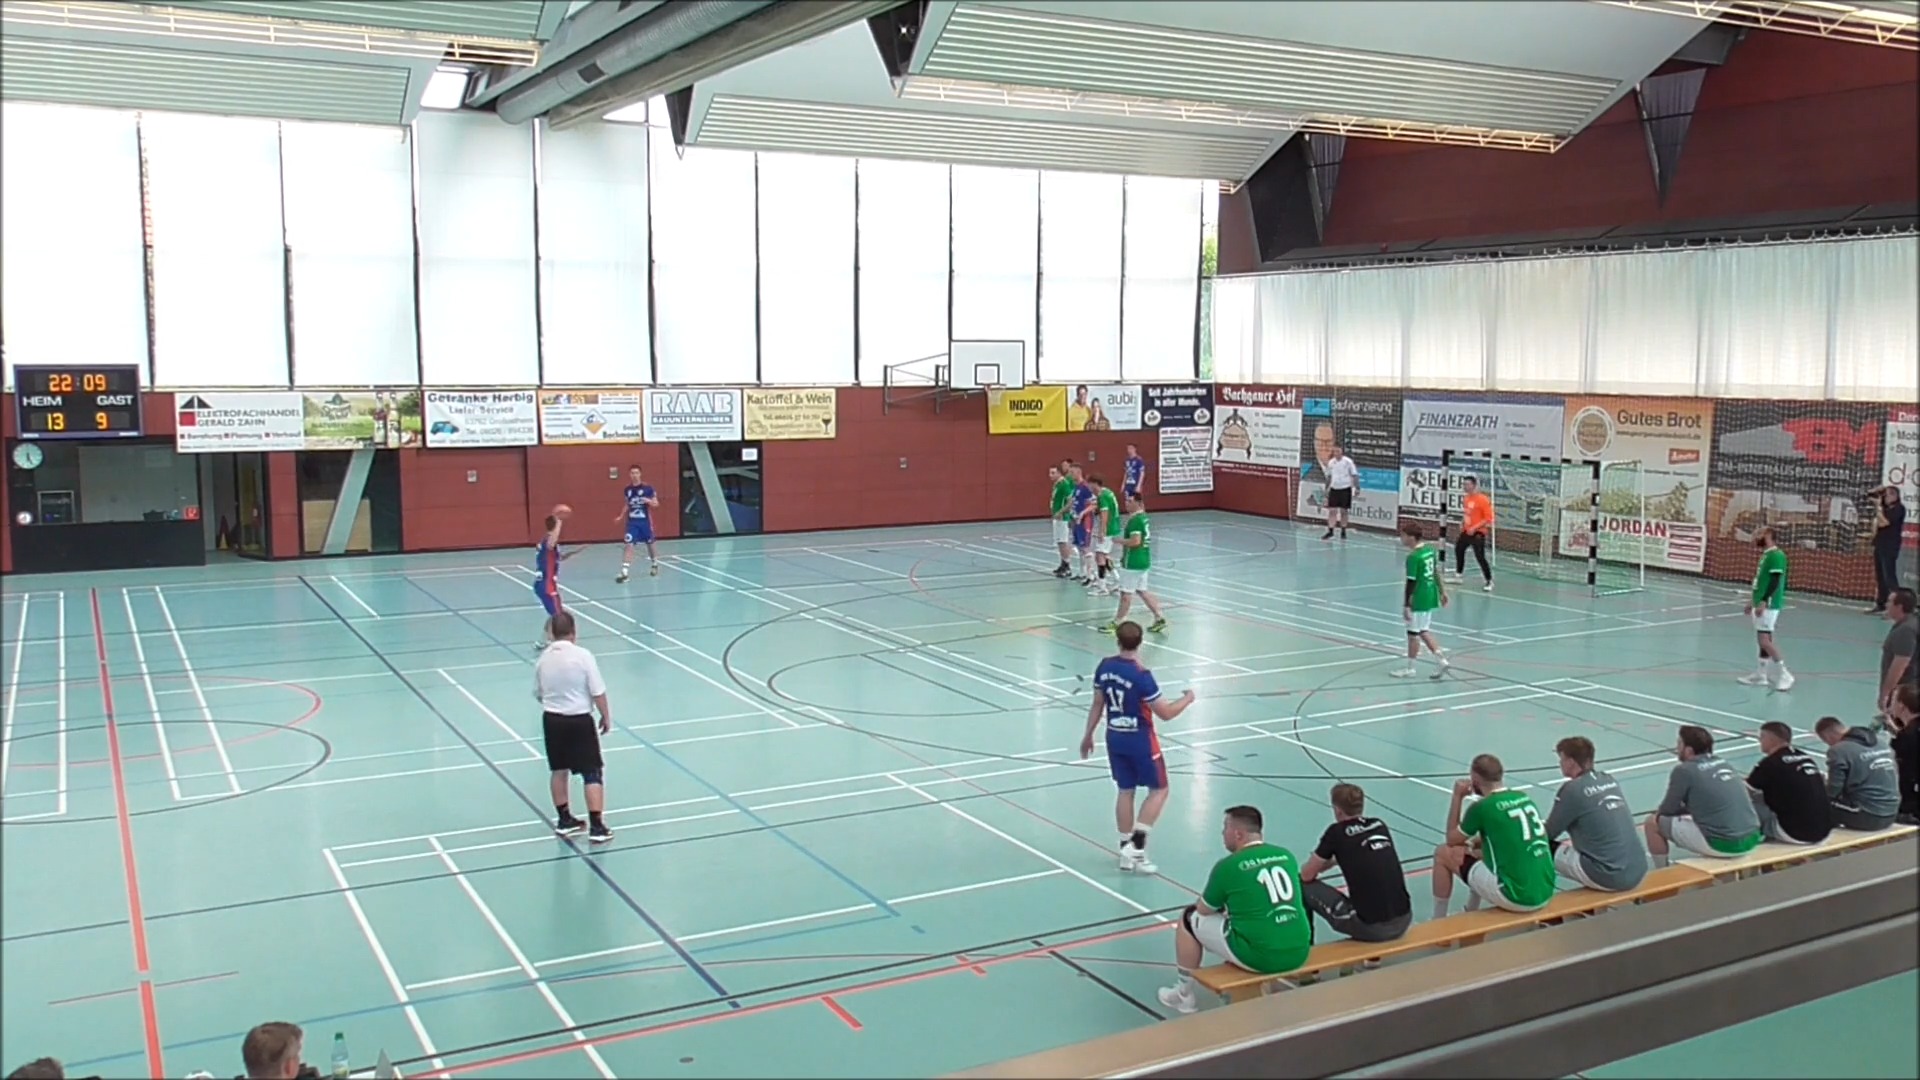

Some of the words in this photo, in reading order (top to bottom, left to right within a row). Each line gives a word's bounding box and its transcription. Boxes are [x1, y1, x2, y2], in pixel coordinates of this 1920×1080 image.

[49, 374, 106, 391] 22:09
[23, 396, 62, 406] HEIM
[97, 395, 133, 405] GAST
[428, 392, 488, 404] Getränke
[492, 392, 533, 404] Herbig
[651, 392, 733, 414] RAAB
[747, 393, 793, 404] Kartoffel
[806, 393, 832, 404] Wein
[1009, 399, 1043, 411] INDIGO
[47, 412, 64, 430] 13
[96, 412, 107, 429] 9
[197, 409, 300, 418] ELEKTROFACHHANDEL
[652, 416, 731, 424] BAUUNTERNEHMEN
[1418, 413, 1499, 429] FINANZRATH
[1617, 409, 1663, 426] Gutes
[1667, 411, 1702, 429] Brot
[198, 419, 235, 427] GERALD
[238, 418, 266, 427] ZAHN
[1428, 471, 1465, 489] EER
[1410, 488, 1465, 509] KELER
[1599, 517, 1666, 537] JORDAN
[1106, 687, 1125, 713] 17
[1507, 804, 1546, 841] 73
[1257, 865, 1293, 904] 10
